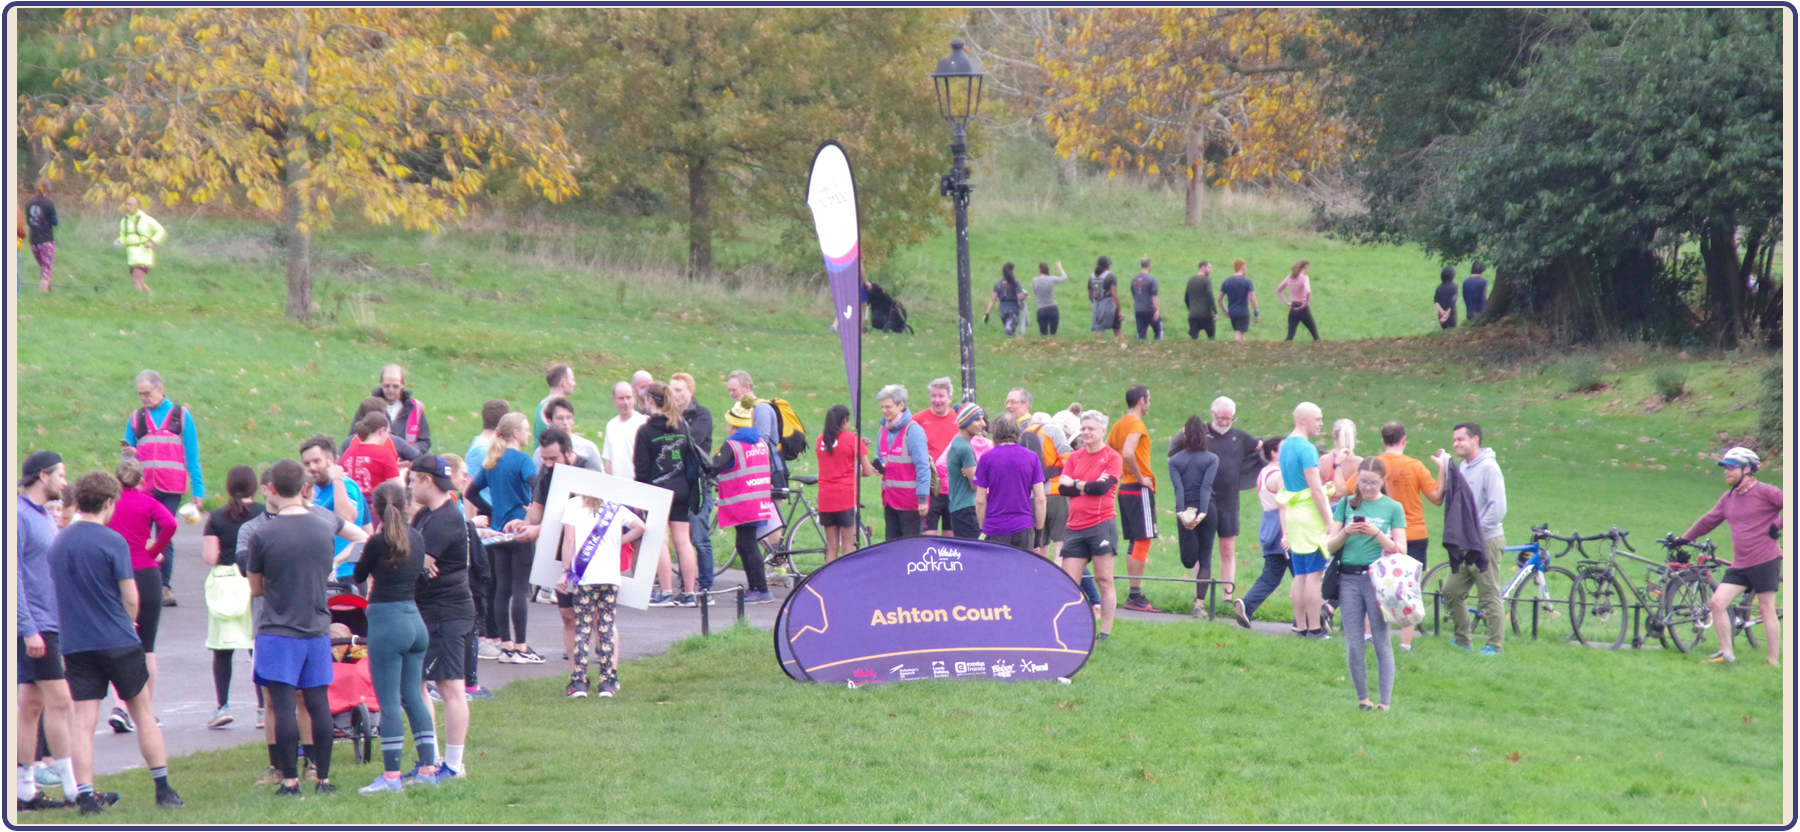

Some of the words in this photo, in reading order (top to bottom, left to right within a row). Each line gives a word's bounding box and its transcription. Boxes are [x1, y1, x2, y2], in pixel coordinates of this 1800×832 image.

[938, 547, 961, 560] Vitality
[907, 555, 963, 575] parkrun
[870, 606, 948, 626] Ashton
[952, 605, 1012, 621] Court
